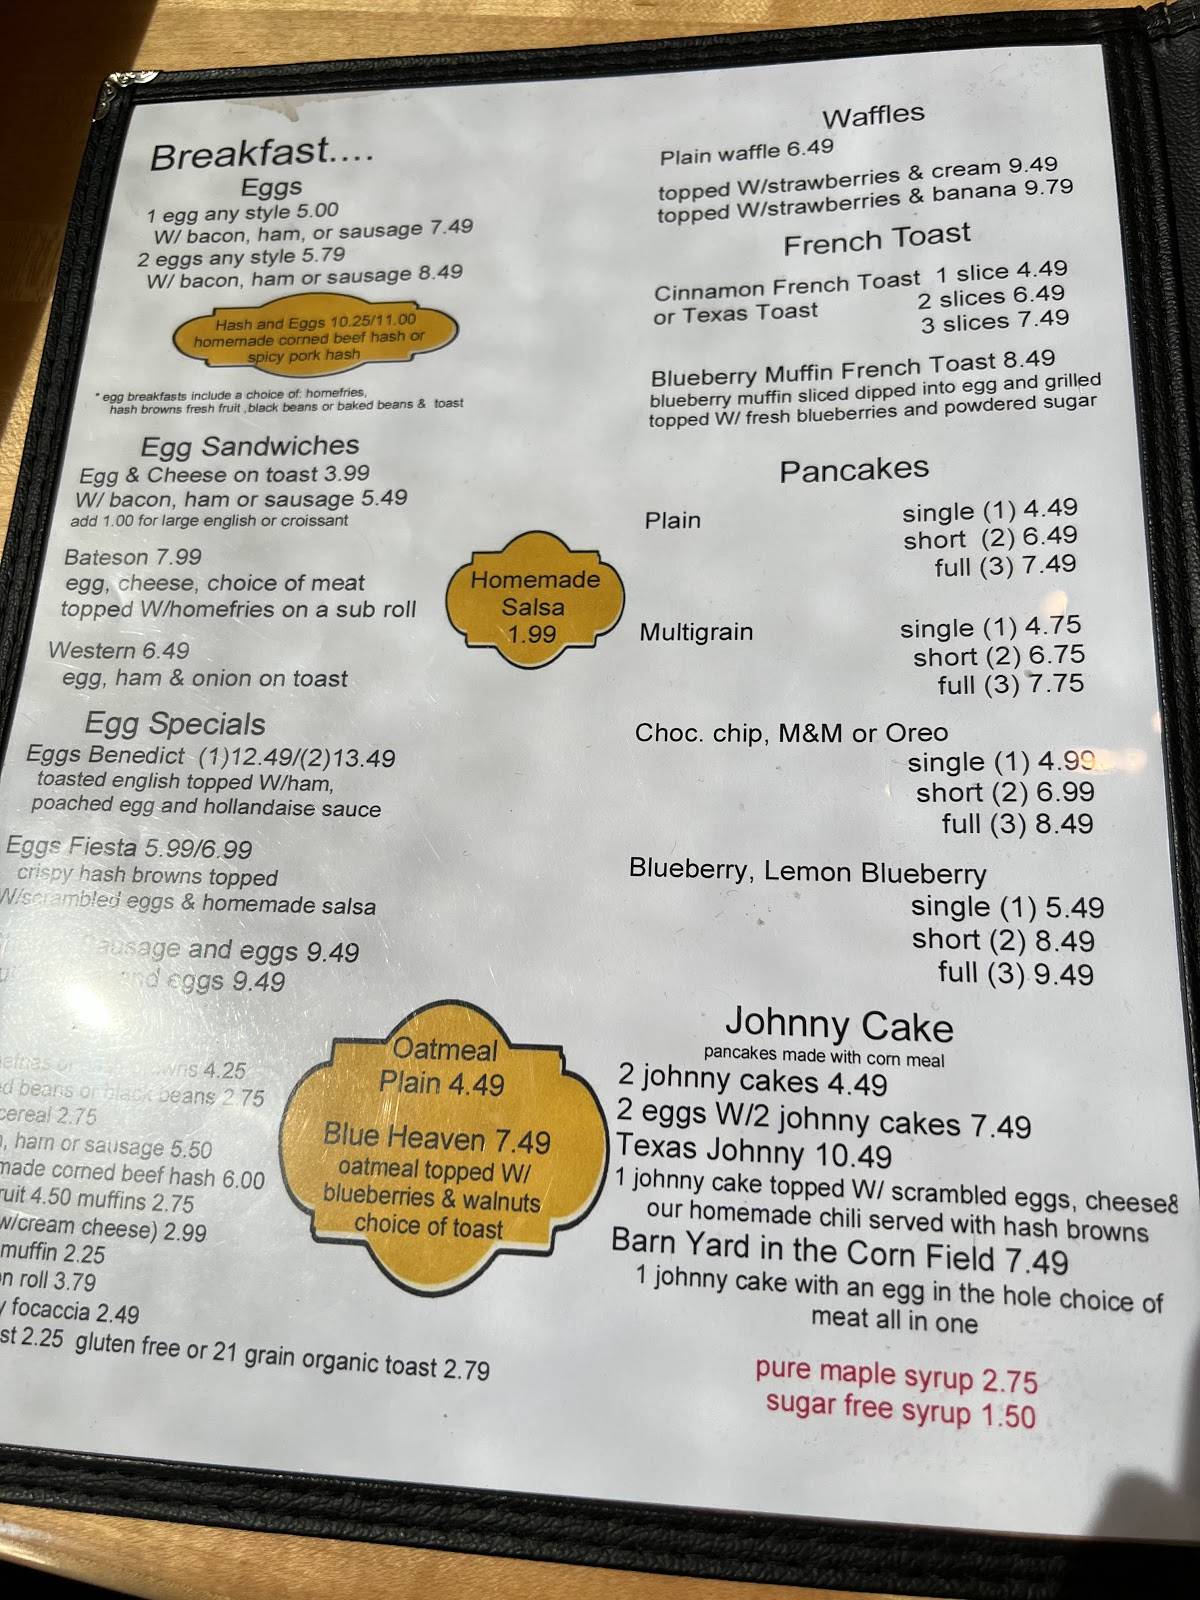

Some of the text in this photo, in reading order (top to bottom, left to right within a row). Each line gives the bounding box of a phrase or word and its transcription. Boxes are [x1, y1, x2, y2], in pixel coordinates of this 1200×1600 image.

[822, 105, 925, 129] Waffles
[150, 136, 373, 171] Breakfast....
[661, 138, 834, 166] Plain waffle 6.49
[241, 178, 302, 201] Eggs
[148, 202, 339, 226] 1 egg any style 5.00
[154, 218, 473, 245] W/ bacon, ham, or sausage 7.49
[785, 222, 971, 256] French Toast
[654, 260, 1067, 302] Cinnamon French Toast 1 slice 4.49
[215, 312, 416, 332] Hash and Eggs 10.25/11.00
[193, 331, 425, 347] homemade corned beef hash or
[248, 348, 360, 365] spicy pork hash
[102, 394, 124, 404] egg
[127, 392, 187, 401] breakfasts
[191, 391, 231, 400] include
[246, 390, 284, 399] choice
[288, 389, 302, 399] of:
[306, 387, 367, 398] homefries,
[649, 395, 1098, 430] topped W/ fresh blueberries and powdered sugar
[141, 435, 359, 462] Egg Sandwiches
[80, 464, 370, 488] Egg & Cheese on toast 3.99
[781, 457, 929, 483] Pancakes
[70, 514, 349, 530] add 1.00 for large english or croissant
[646, 511, 700, 529] Plain
[903, 498, 1077, 526] single (1) 4.49
[64, 548, 201, 565] Bateson 7.99
[471, 571, 600, 588] Homemade
[61, 600, 416, 621] topped W/homefries on a sub roll
[502, 598, 565, 616] Salsa
[509, 625, 556, 643] 1.99
[641, 622, 753, 645] Multigrain
[49, 641, 189, 659] Western 6.49
[85, 711, 265, 740] Egg Specials
[636, 723, 948, 747] Choc. chip, M&M or Oreo
[26, 744, 395, 771] Eggs Benedict (1)12.49/(2)13.49
[31, 795, 381, 817] poached egg and hollandaise sauce
[942, 813, 1093, 839] full (3) 8.49
[6, 835, 252, 859] Eggs Fiesta 5.99/6.99
[630, 857, 987, 890] Blueberry, Lemon Blueberry
[726, 1005, 953, 1046] Johnny Cake
[393, 1037, 497, 1061] Oatmeal
[704, 1045, 944, 1068] pancakes made with corn meal
[380, 1070, 504, 1096] Plain 4.49
[324, 1121, 551, 1154] Blue Heaven 7.49
[616, 1132, 892, 1171] Texas Johnny 10.49
[324, 1182, 540, 1213] blueberries & walnuts
[0, 1241, 106, 1264] muffin 2.25
[612, 1226, 1068, 1276] Barn Yard in the Corn Field 7.49
[21, 1328, 490, 1381] 2.25 gluten free or 21 grain organic toast 2.79
[757, 1359, 1038, 1396] pure maple syrup 2.75
